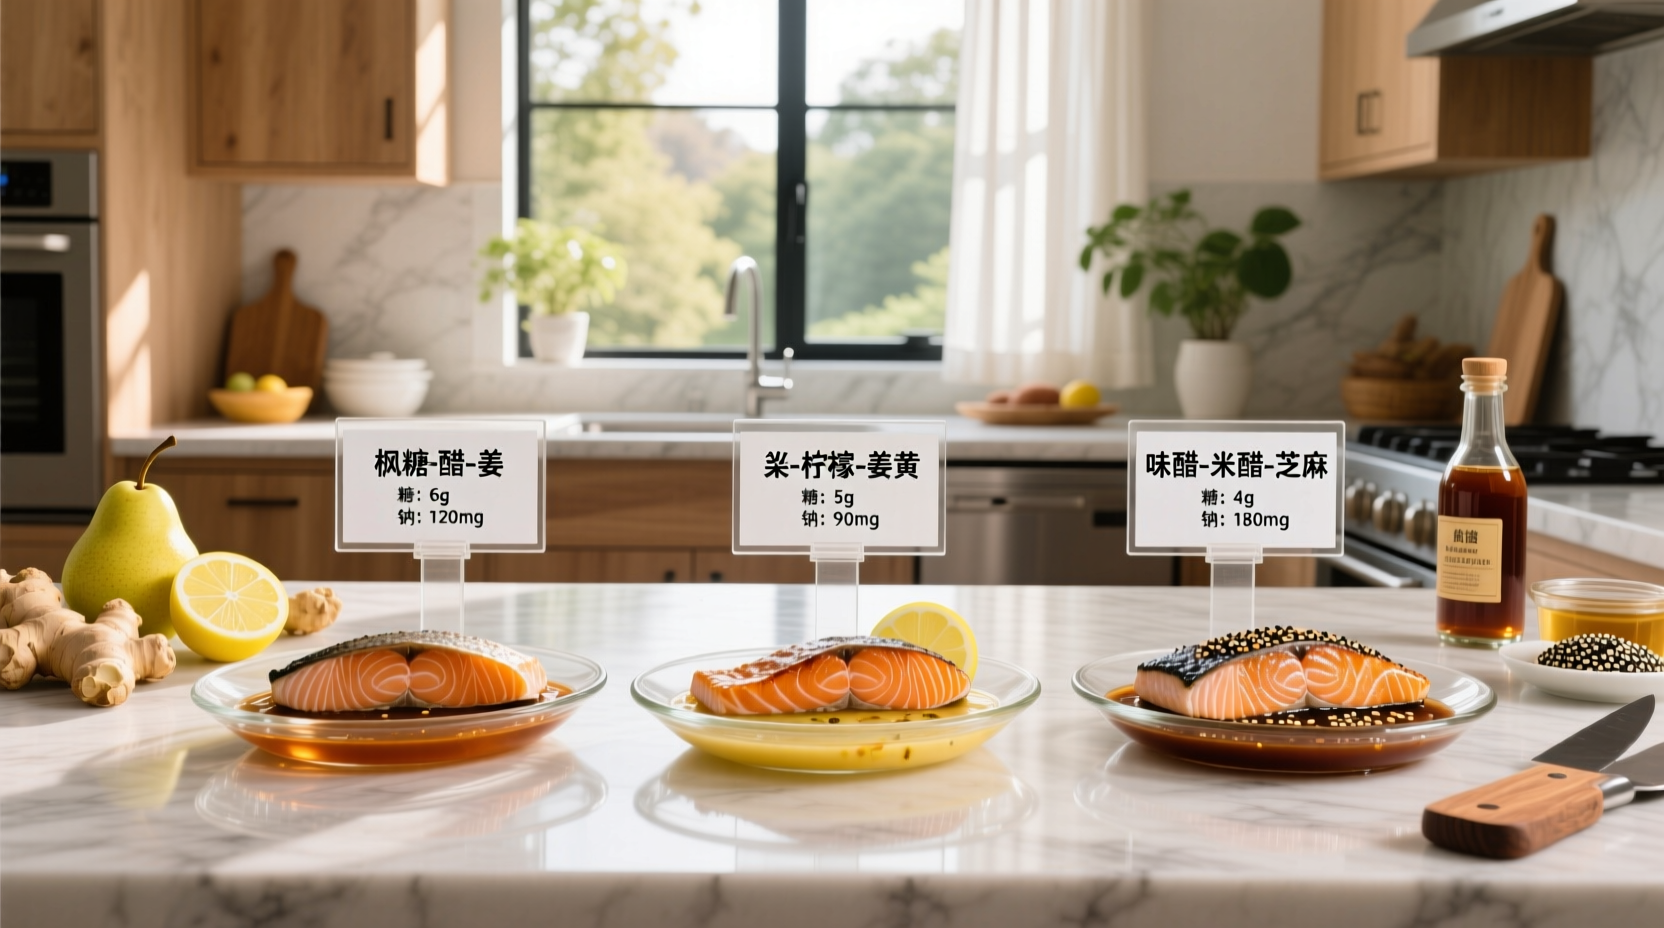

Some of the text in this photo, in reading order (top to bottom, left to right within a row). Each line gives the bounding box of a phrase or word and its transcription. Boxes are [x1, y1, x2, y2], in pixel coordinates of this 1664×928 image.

[374, 448, 504, 478] 枫糖-醋-姜
[1146, 449, 1328, 480] 味醋-米醋-芝麻
